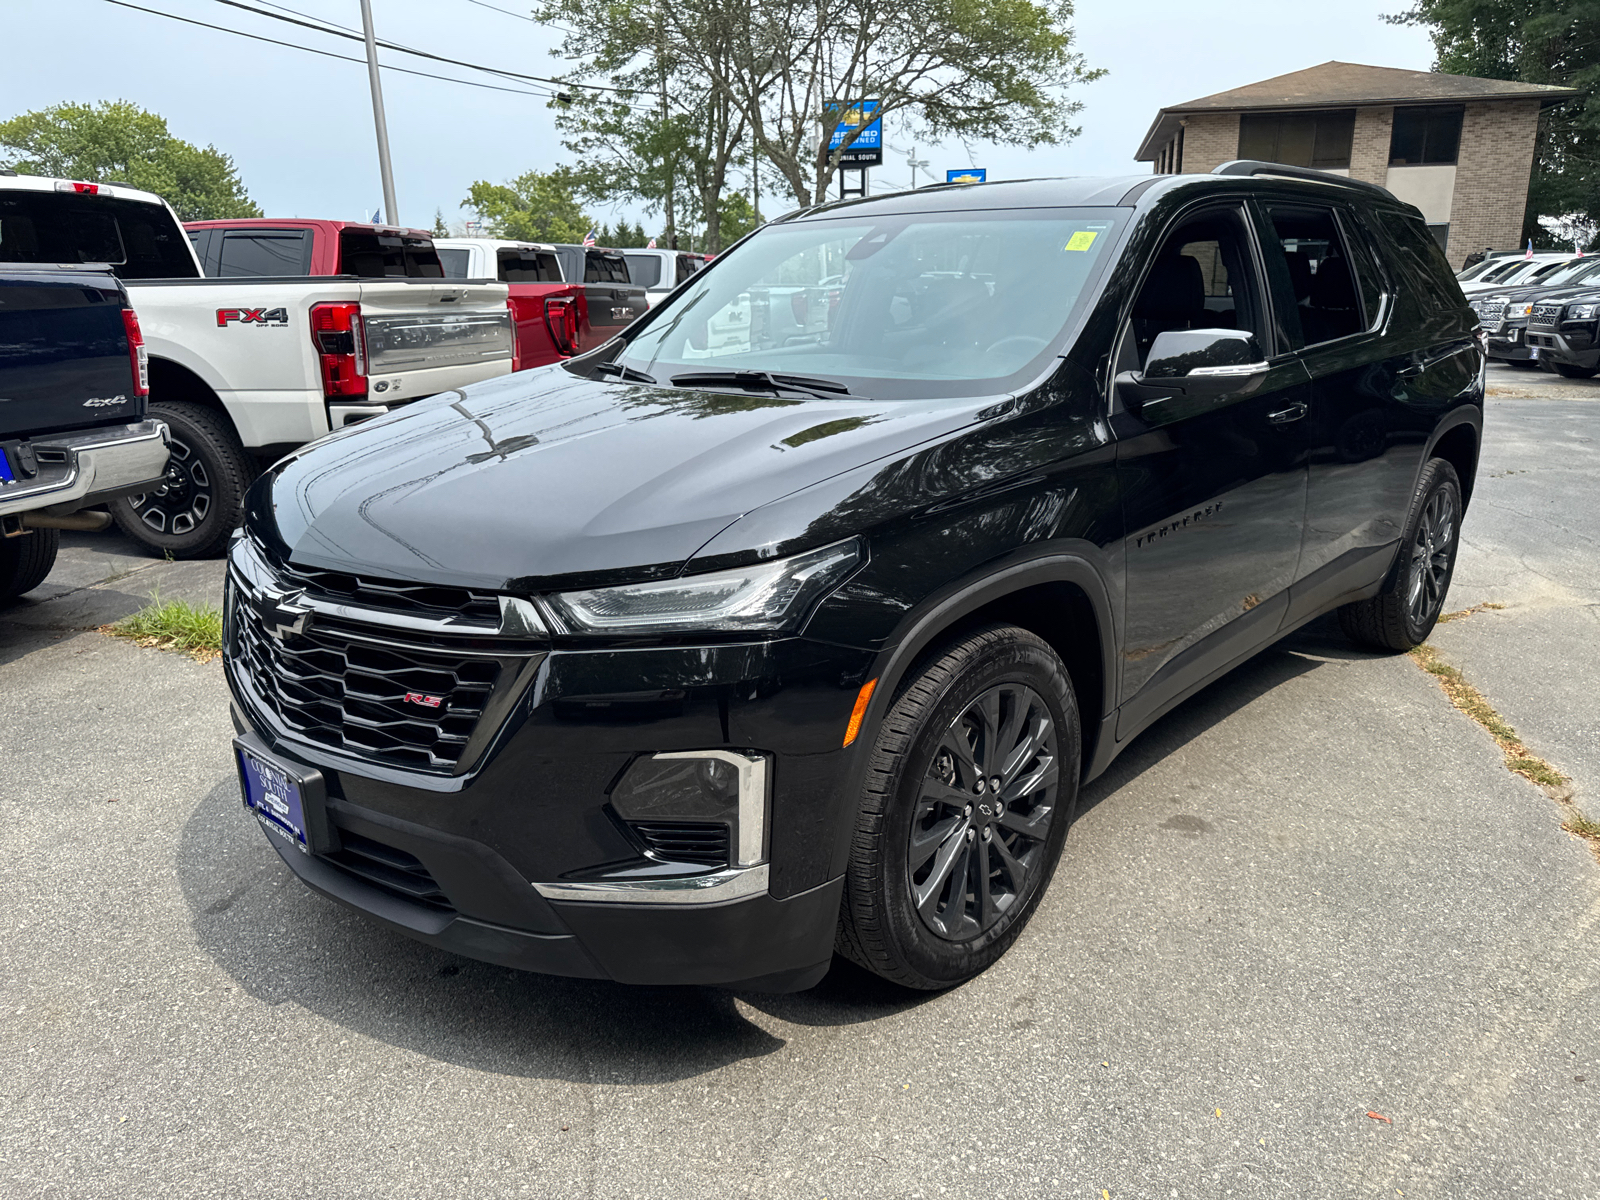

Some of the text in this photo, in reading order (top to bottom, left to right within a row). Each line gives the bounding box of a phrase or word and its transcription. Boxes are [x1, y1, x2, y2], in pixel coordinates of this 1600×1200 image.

[858, 153, 877, 161] SOUTH
[215, 307, 288, 327] FX4
[1136, 501, 1223, 548] TRAVERSE
[403, 692, 442, 708] RS
[259, 774, 288, 802] SOUTH
